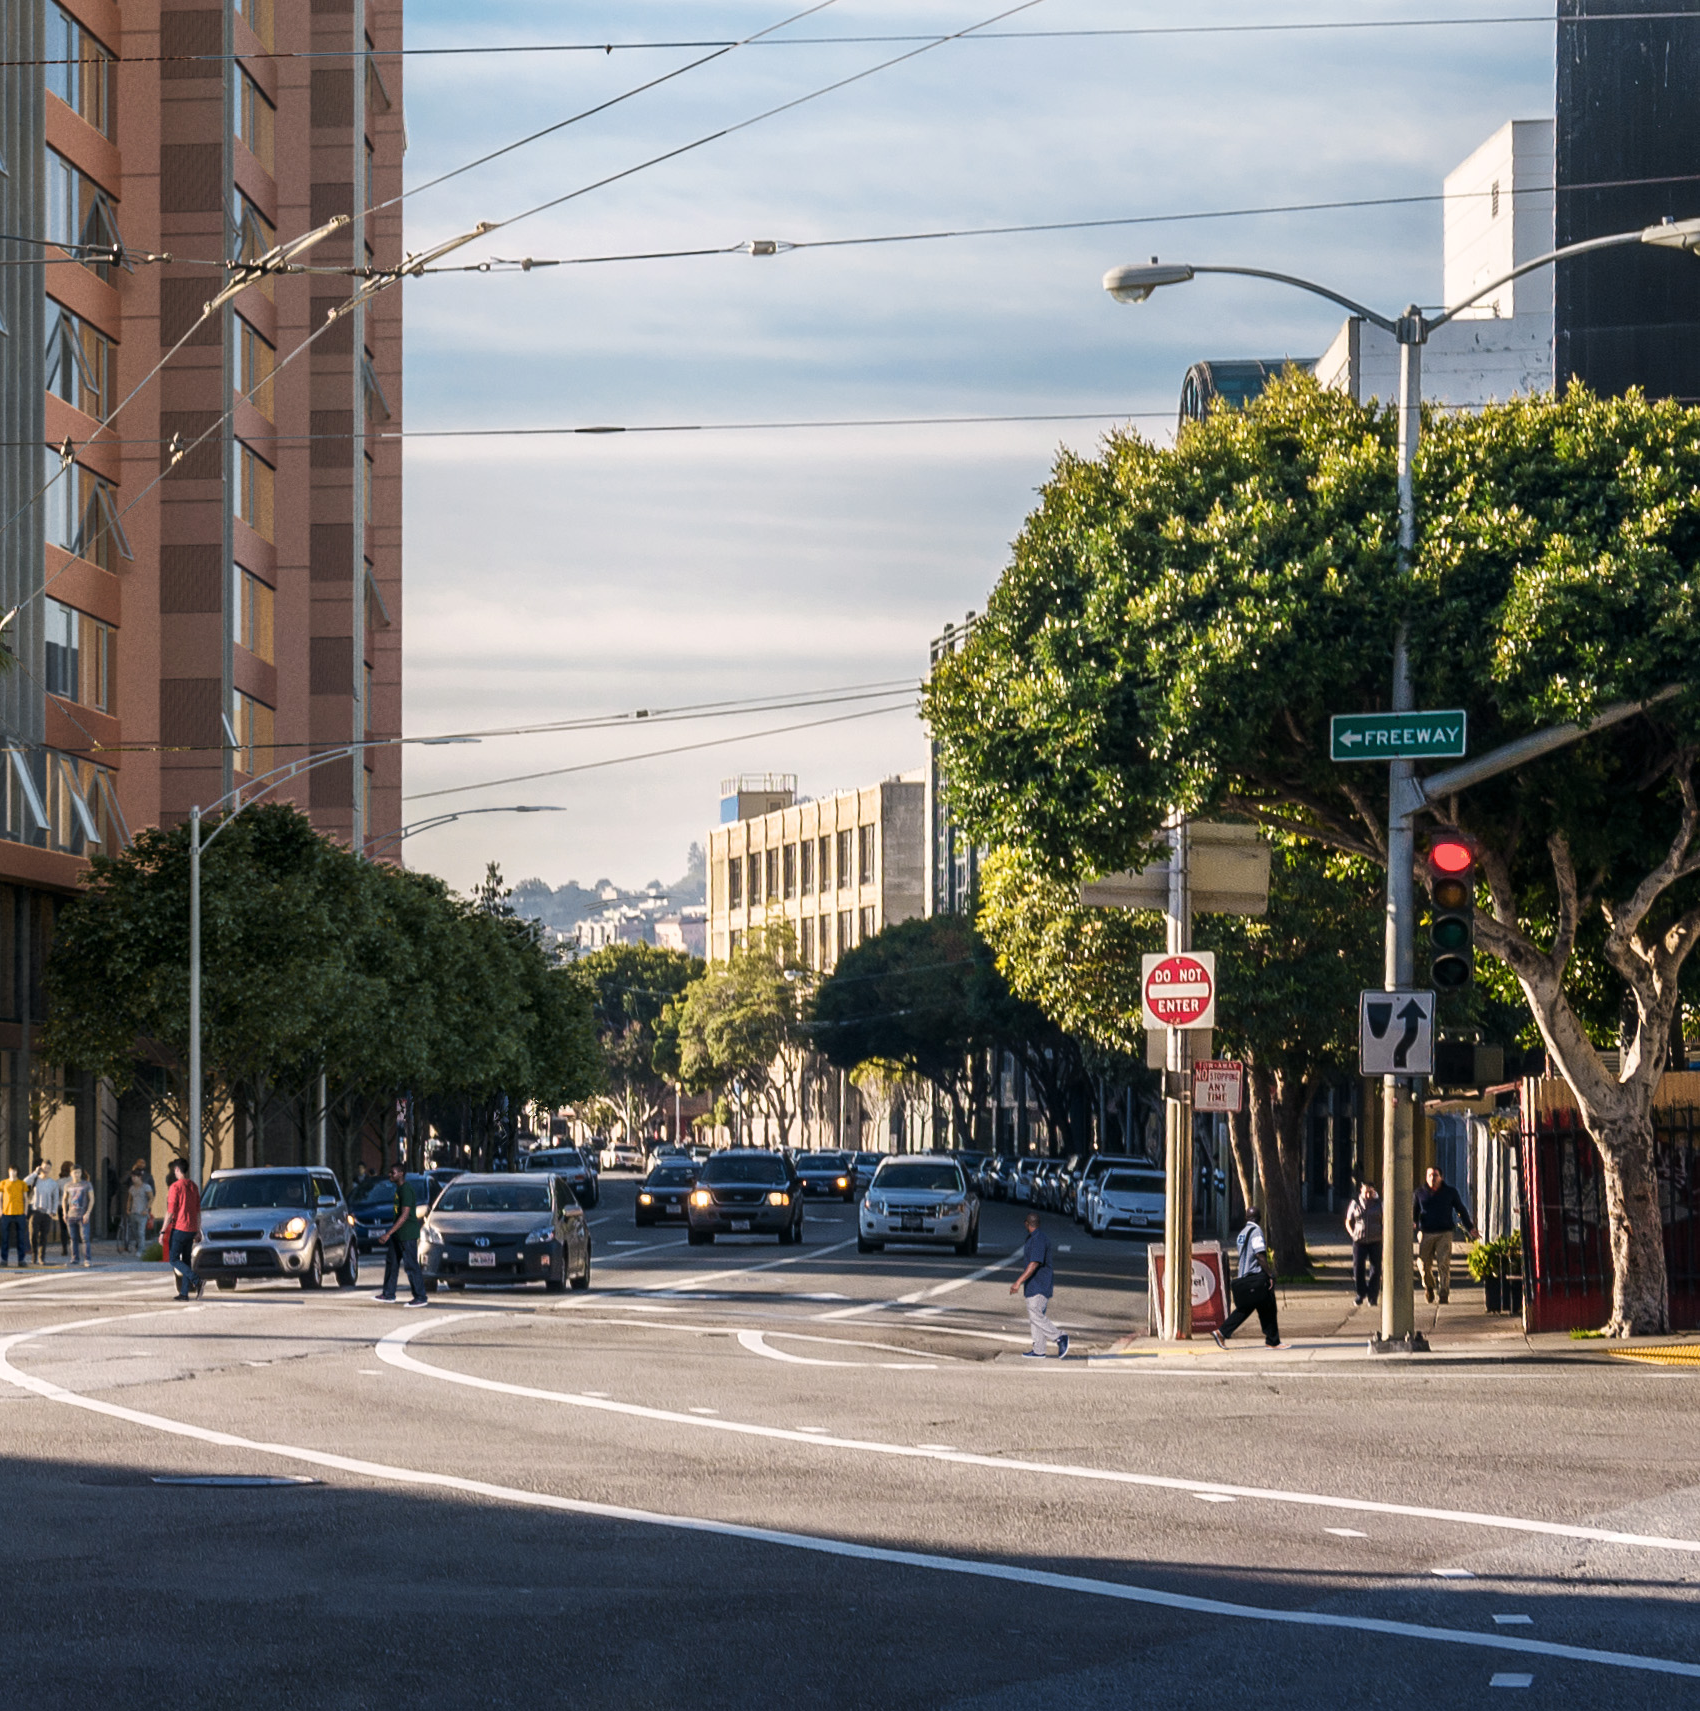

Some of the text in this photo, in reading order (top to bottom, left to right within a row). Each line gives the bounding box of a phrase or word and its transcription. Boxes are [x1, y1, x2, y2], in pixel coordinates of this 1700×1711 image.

[1364, 726, 1460, 747] FREEWAY
[1155, 968, 1203, 983] DO NOT
[1158, 999, 1199, 1013] ENTER
[1195, 1068, 1208, 1082] NO
[1208, 1082, 1227, 1092] ANY
[1207, 1092, 1228, 1102] TIME
